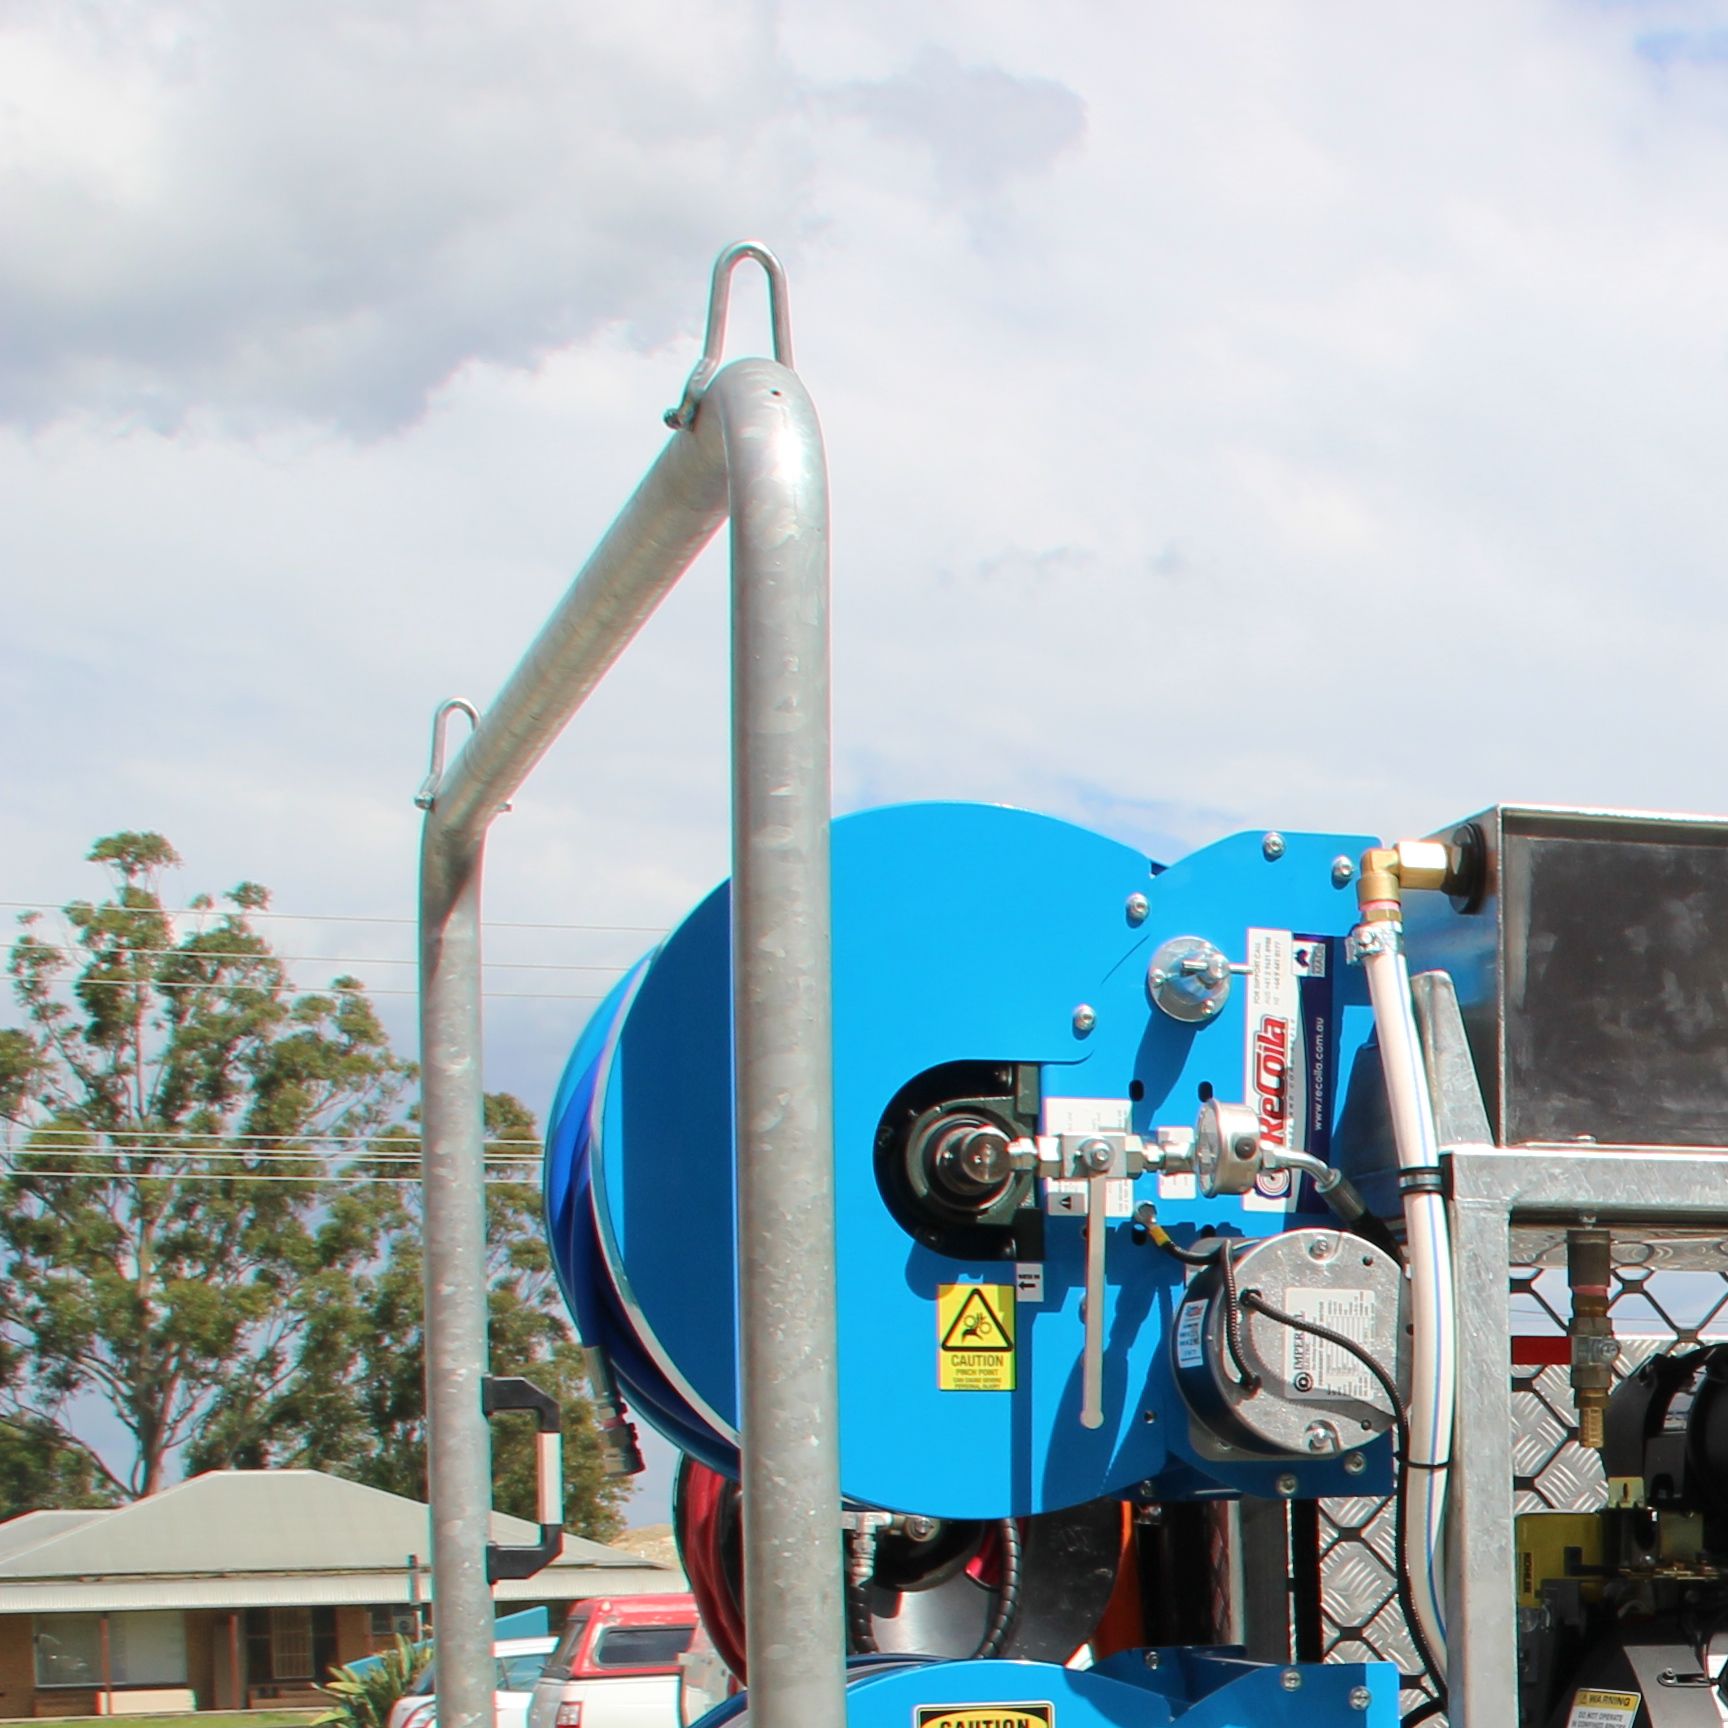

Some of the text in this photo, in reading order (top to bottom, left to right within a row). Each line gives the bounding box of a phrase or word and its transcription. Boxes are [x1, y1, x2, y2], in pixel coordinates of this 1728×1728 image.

[1313, 1016, 1325, 1131] www.recoila.com.au
[1293, 1310, 1305, 1371] IMPERL
[951, 1354, 1004, 1367] CAUTION
[1588, 1694, 1632, 1707] WARNING
[1587, 1711, 1598, 1719] NOT
[1598, 1713, 1624, 1721] OPERATE
